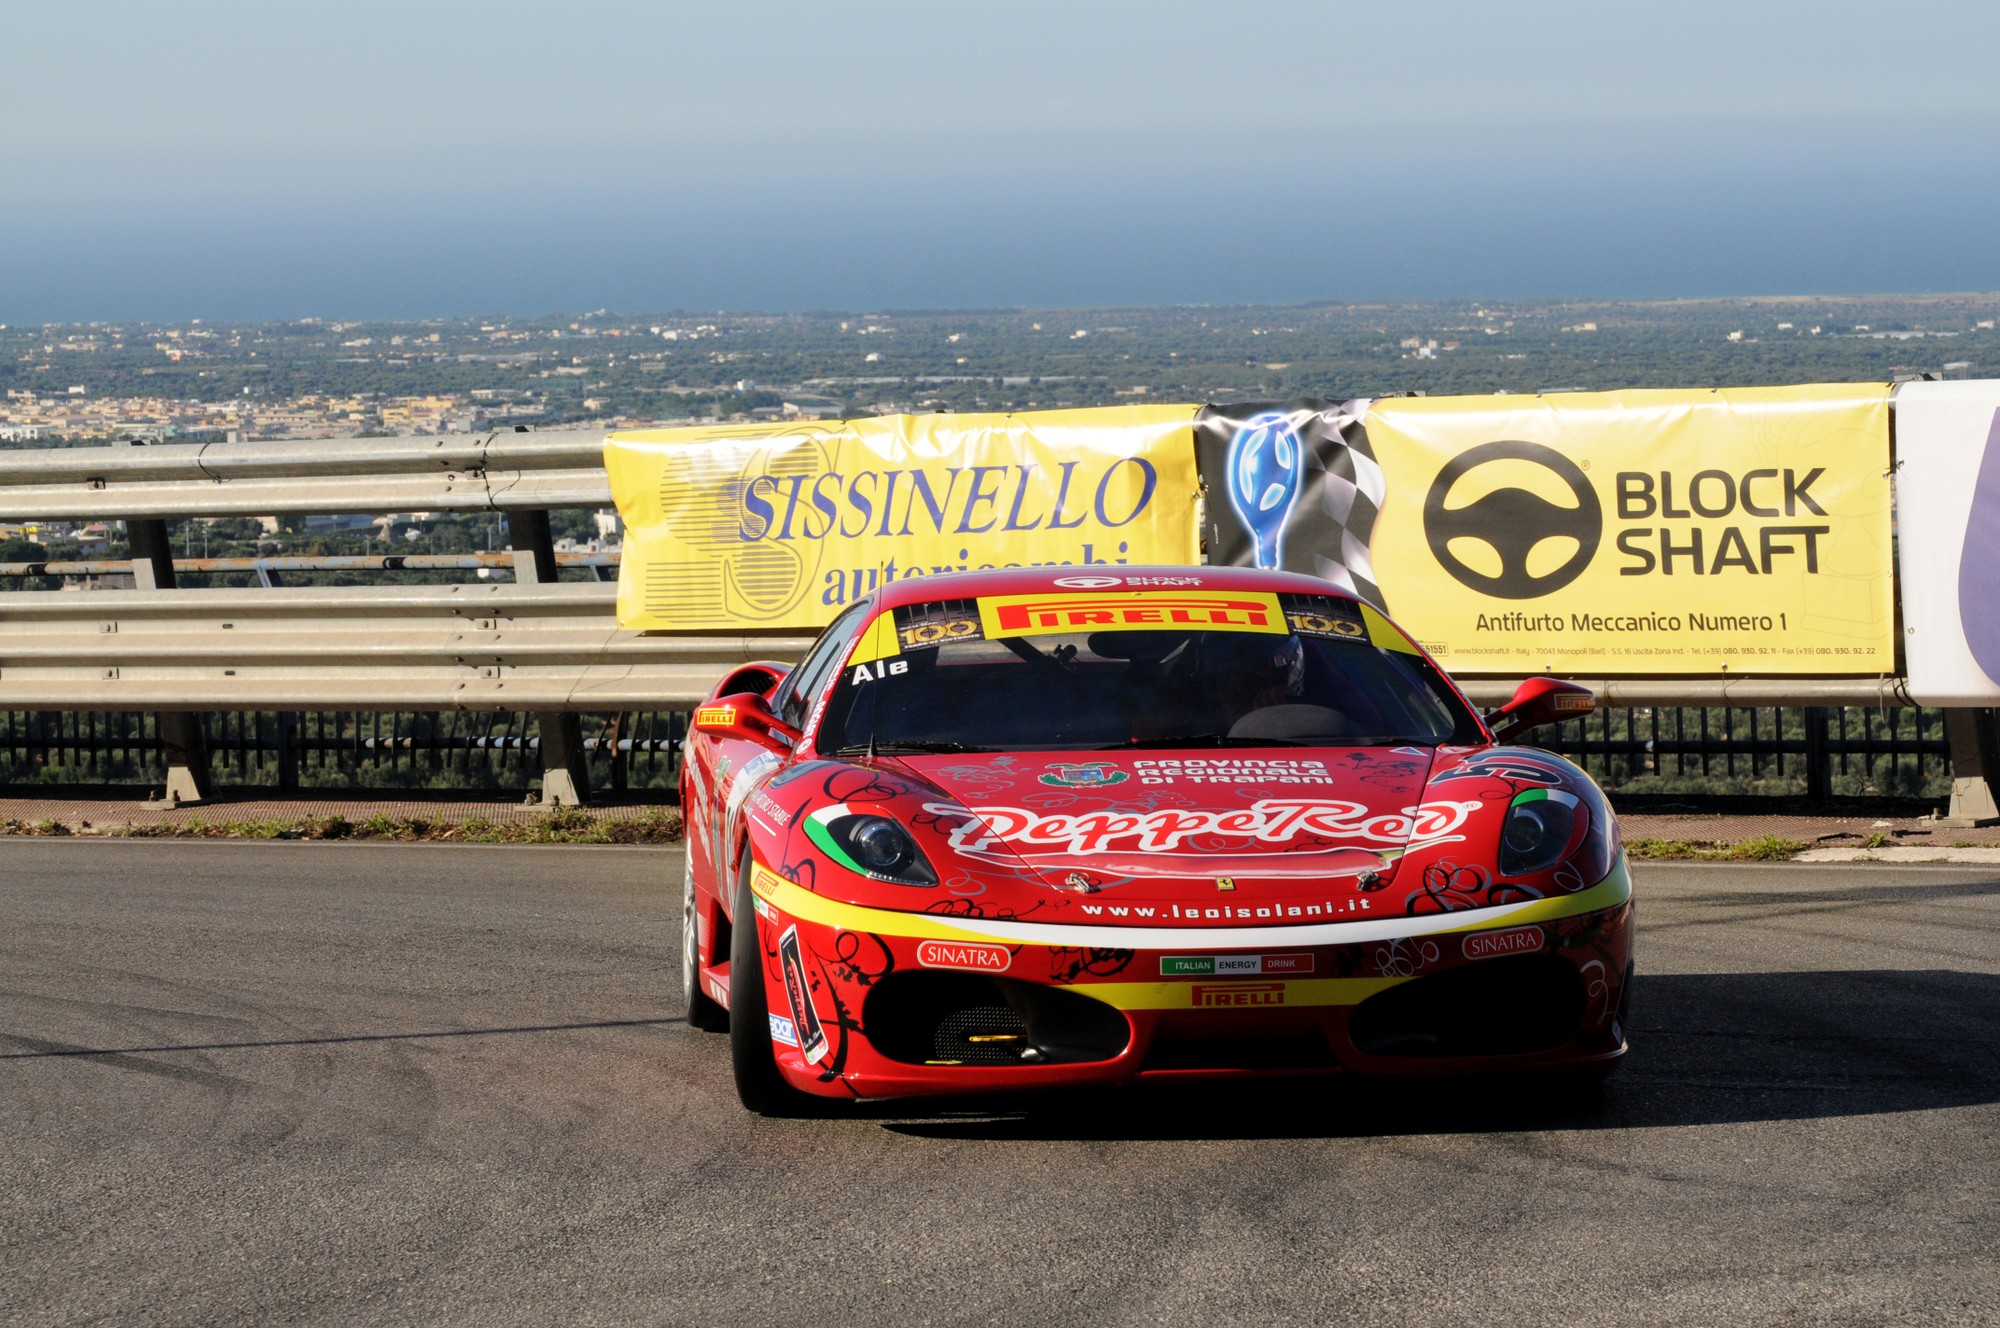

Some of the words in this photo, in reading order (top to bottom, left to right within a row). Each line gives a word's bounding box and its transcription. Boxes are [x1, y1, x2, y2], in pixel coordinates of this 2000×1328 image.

[739, 456, 1157, 542] SISSINELLO
[1616, 467, 1830, 520] BLOCK
[1619, 525, 1831, 576] SHAFT
[997, 599, 1269, 631] PIRELLI
[1287, 614, 1363, 636] 100
[1475, 612, 1566, 632] Antifurto
[1572, 611, 1682, 632] Meccanico
[1689, 612, 1774, 631] Numero
[1779, 613, 1787, 631] 1
[900, 620, 979, 645] 100
[1421, 644, 1447, 655] 51551
[1454, 647, 1511, 655] www.blockshaft.it
[1516, 647, 1530, 656] Italy
[1557, 647, 1588, 656] Monopoli
[1782, 647, 1795, 655] Fax
[1866, 647, 1876, 655] 22
[852, 659, 909, 686] Ale
[699, 709, 734, 724] PIRELLI
[1133, 760, 1325, 769] PROVINCIA
[1137, 768, 1330, 776] REGIONALE
[1141, 776, 1175, 785] DI
[1185, 776, 1334, 784] TRAPANI
[754, 870, 779, 896] PIRELLI
[1081, 897, 1370, 919] www.leoisolani.it
[1471, 931, 1537, 954] SINATRA
[927, 945, 1001, 967] SINATRA
[1175, 961, 1211, 970] ITALIAN
[1218, 960, 1257, 970] ENERGY
[1267, 959, 1296, 969] DRINK
[1191, 982, 1286, 1007] PIRELLI
